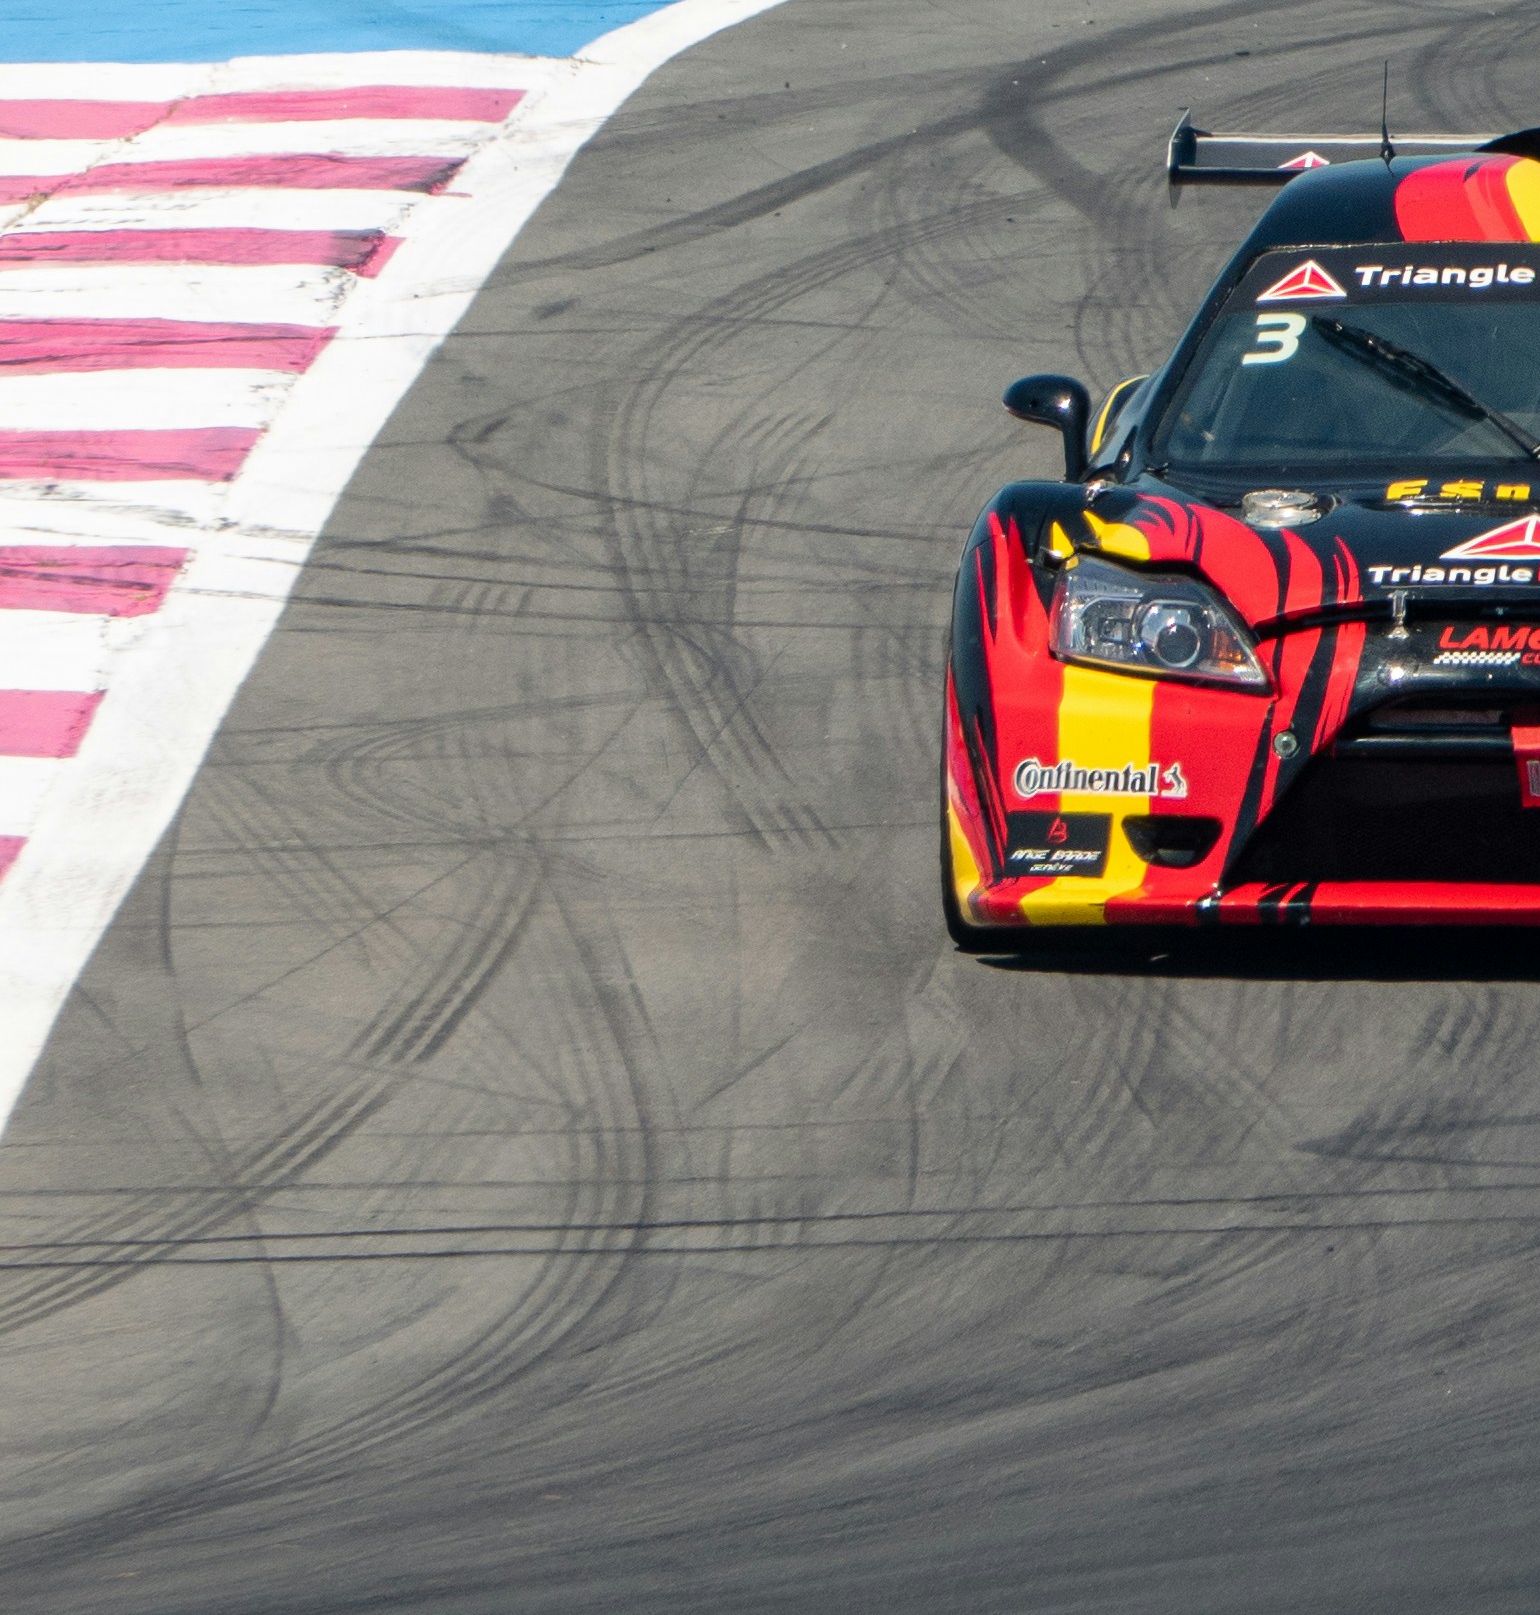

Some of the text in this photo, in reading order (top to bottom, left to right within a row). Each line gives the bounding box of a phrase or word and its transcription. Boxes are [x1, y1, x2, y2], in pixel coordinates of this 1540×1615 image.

[1354, 264, 1536, 288] Triangle
[1242, 312, 1307, 365] 3
[1368, 565, 1533, 585] Triangle
[1014, 757, 1160, 798] Continental
